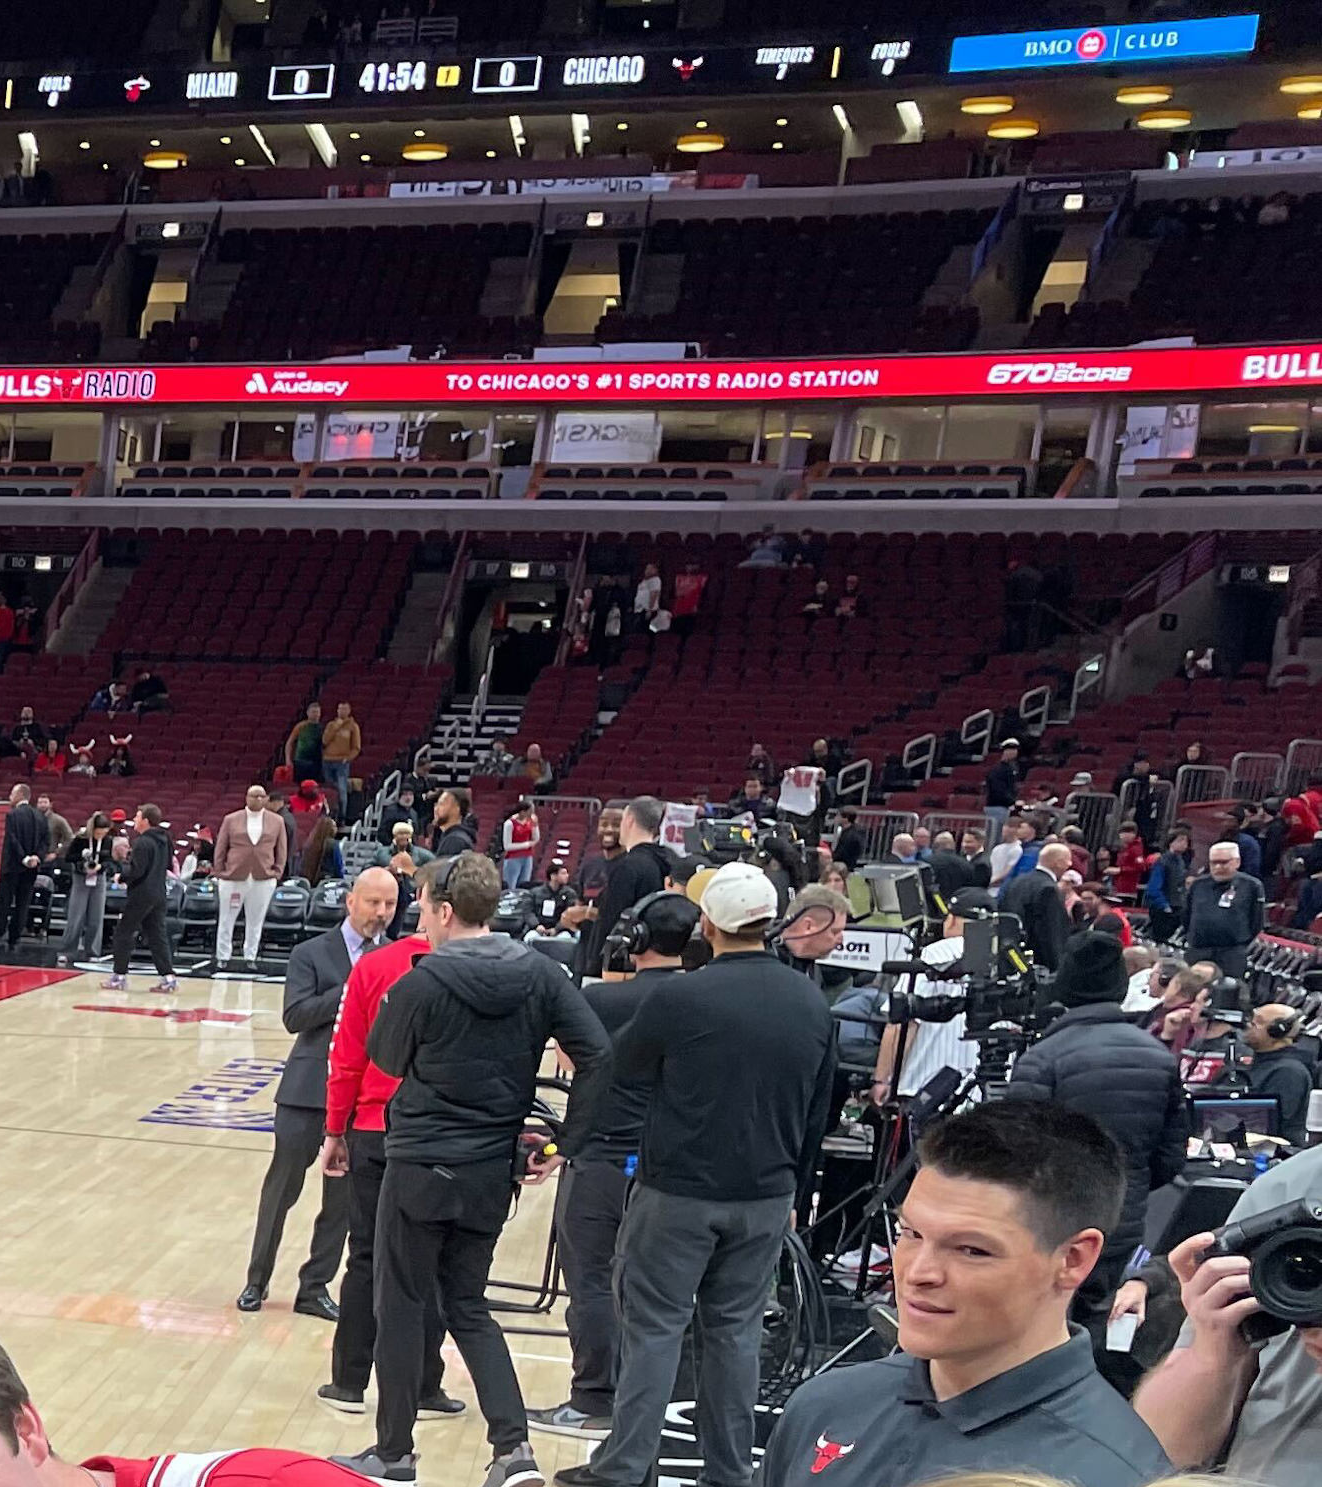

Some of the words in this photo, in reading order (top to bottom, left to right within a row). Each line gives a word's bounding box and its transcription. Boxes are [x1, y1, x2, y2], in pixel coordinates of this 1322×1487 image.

[871, 41, 911, 59] FOULS
[1024, 40, 1072, 57] BMO
[1125, 31, 1179, 49] CLUB
[293, 69, 309, 94] 0
[358, 61, 426, 92] 41:54
[499, 61, 515, 86] 0
[563, 56, 645, 85] CHICAGO
[38, 75, 71, 92] FOULS
[186, 71, 238, 98] MIAMI
[83, 371, 156, 400] RADIO
[446, 374, 473, 390] TO
[476, 373, 590, 391] CHICAGO'S
[595, 373, 623, 390] #1
[628, 372, 711, 390] SPORTS
[716, 372, 784, 390] RADIO
[787, 369, 879, 389] STATION
[987, 362, 1055, 384] 670
[1054, 366, 1132, 383] SCORE
[270, 377, 349, 396] Audacy
